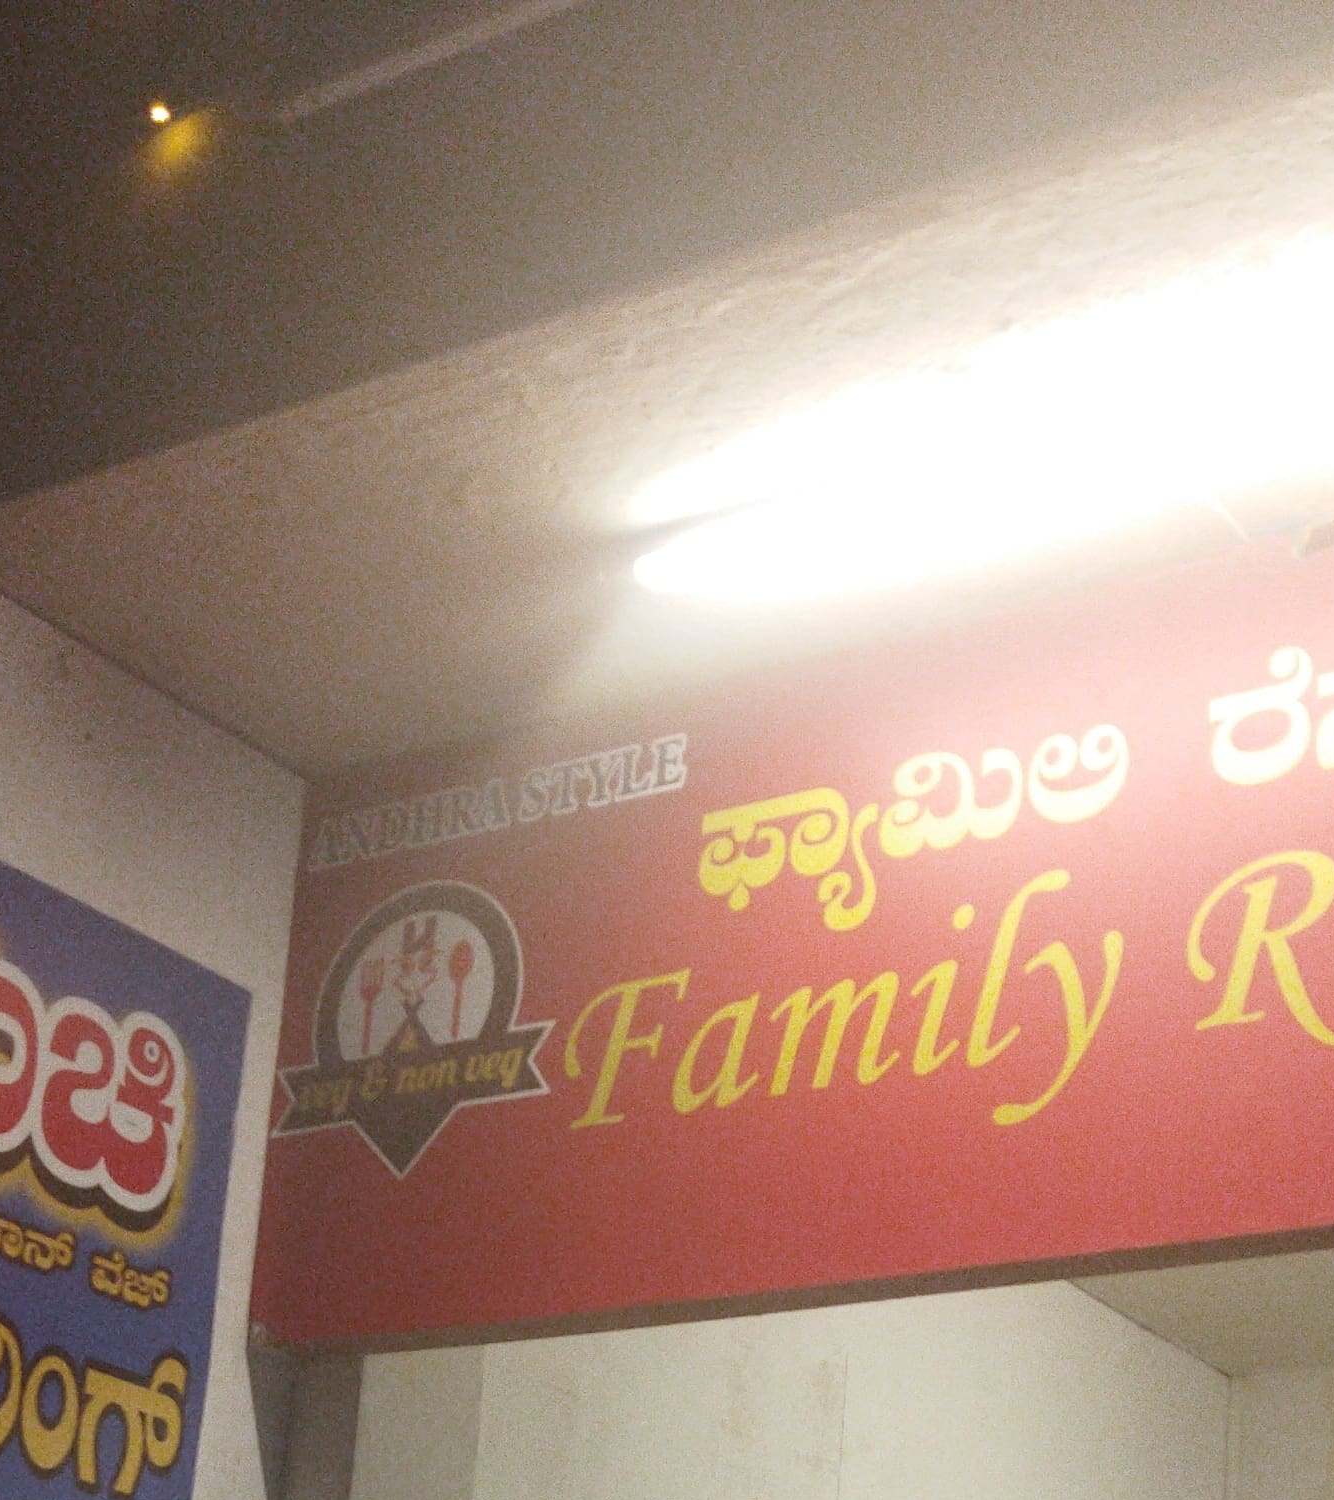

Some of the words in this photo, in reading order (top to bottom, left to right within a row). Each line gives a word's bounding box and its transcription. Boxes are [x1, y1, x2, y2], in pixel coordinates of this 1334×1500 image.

[308, 777, 511, 872] ANDHRA
[518, 732, 688, 822] STYLE
[699, 724, 1129, 931] ಫ್ಯಾಮಿಲಿ
[565, 869, 1124, 1127] Family
[299, 1078, 353, 1116] veg
[395, 1058, 457, 1094] non
[464, 1048, 523, 1087] veg
[91, 1252, 171, 1309] ವೆಜ್
